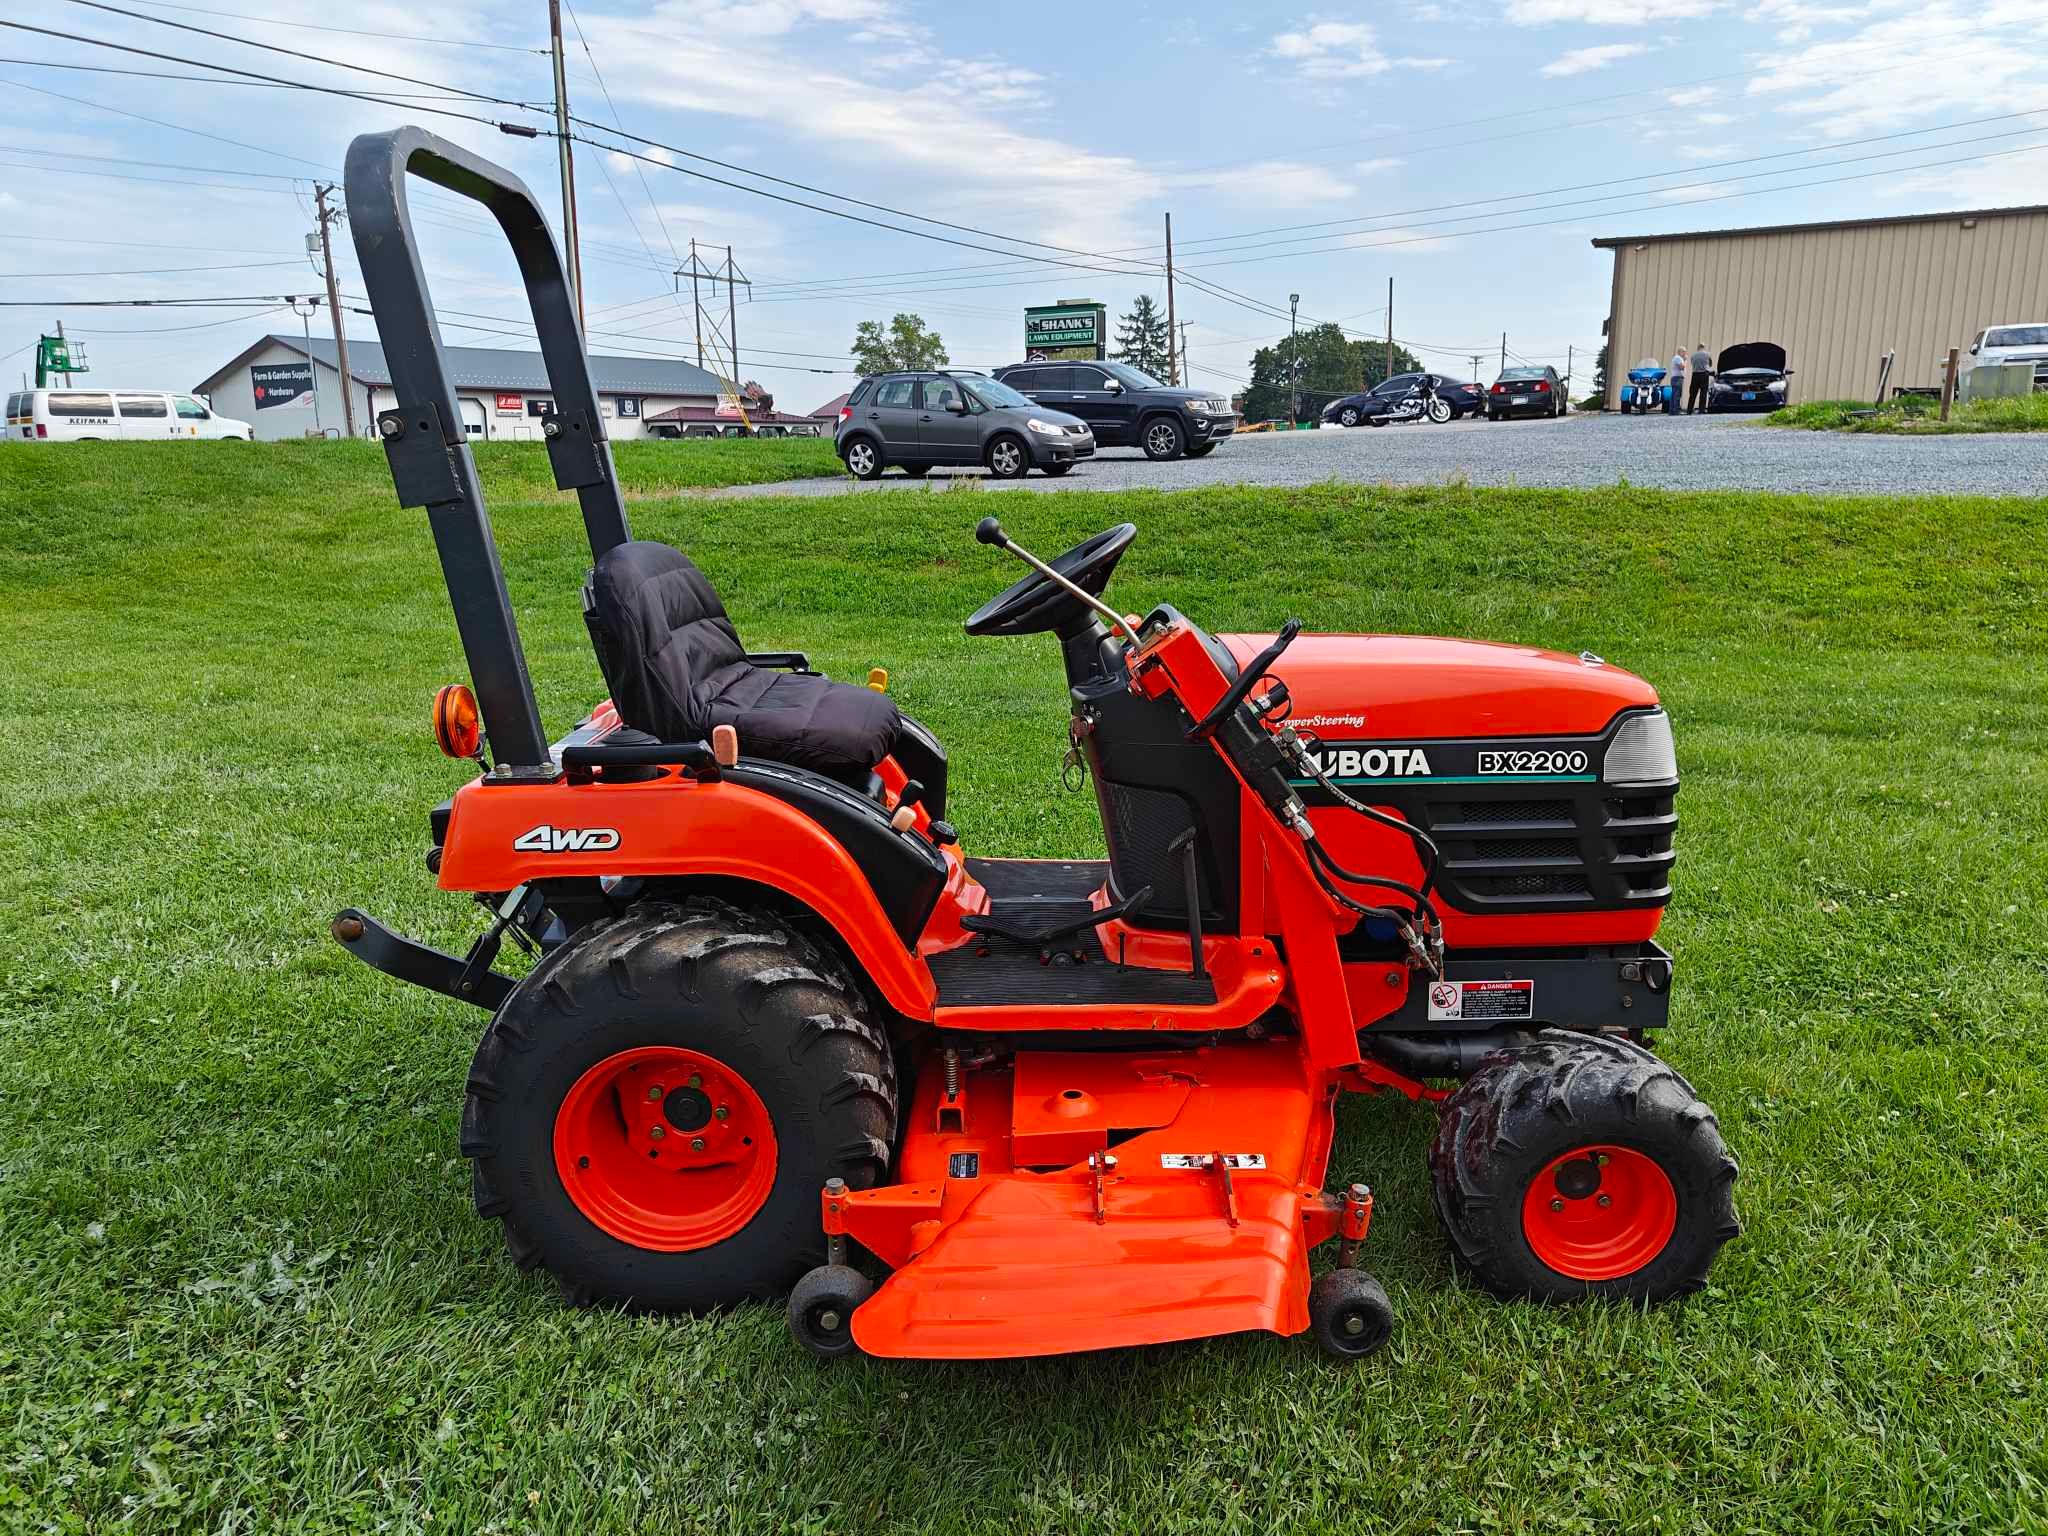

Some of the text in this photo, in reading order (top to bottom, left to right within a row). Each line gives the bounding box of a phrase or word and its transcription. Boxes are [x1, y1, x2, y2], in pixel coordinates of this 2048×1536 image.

[1041, 318, 1093, 331] SHANK'S
[1051, 331, 1092, 340] EQUIPMENT
[273, 370, 292, 380] Garden
[292, 369, 312, 380] Supplie
[1300, 748, 1432, 777] UBOTA
[1478, 750, 1588, 773] BX2200
[514, 825, 620, 851] 4WD
